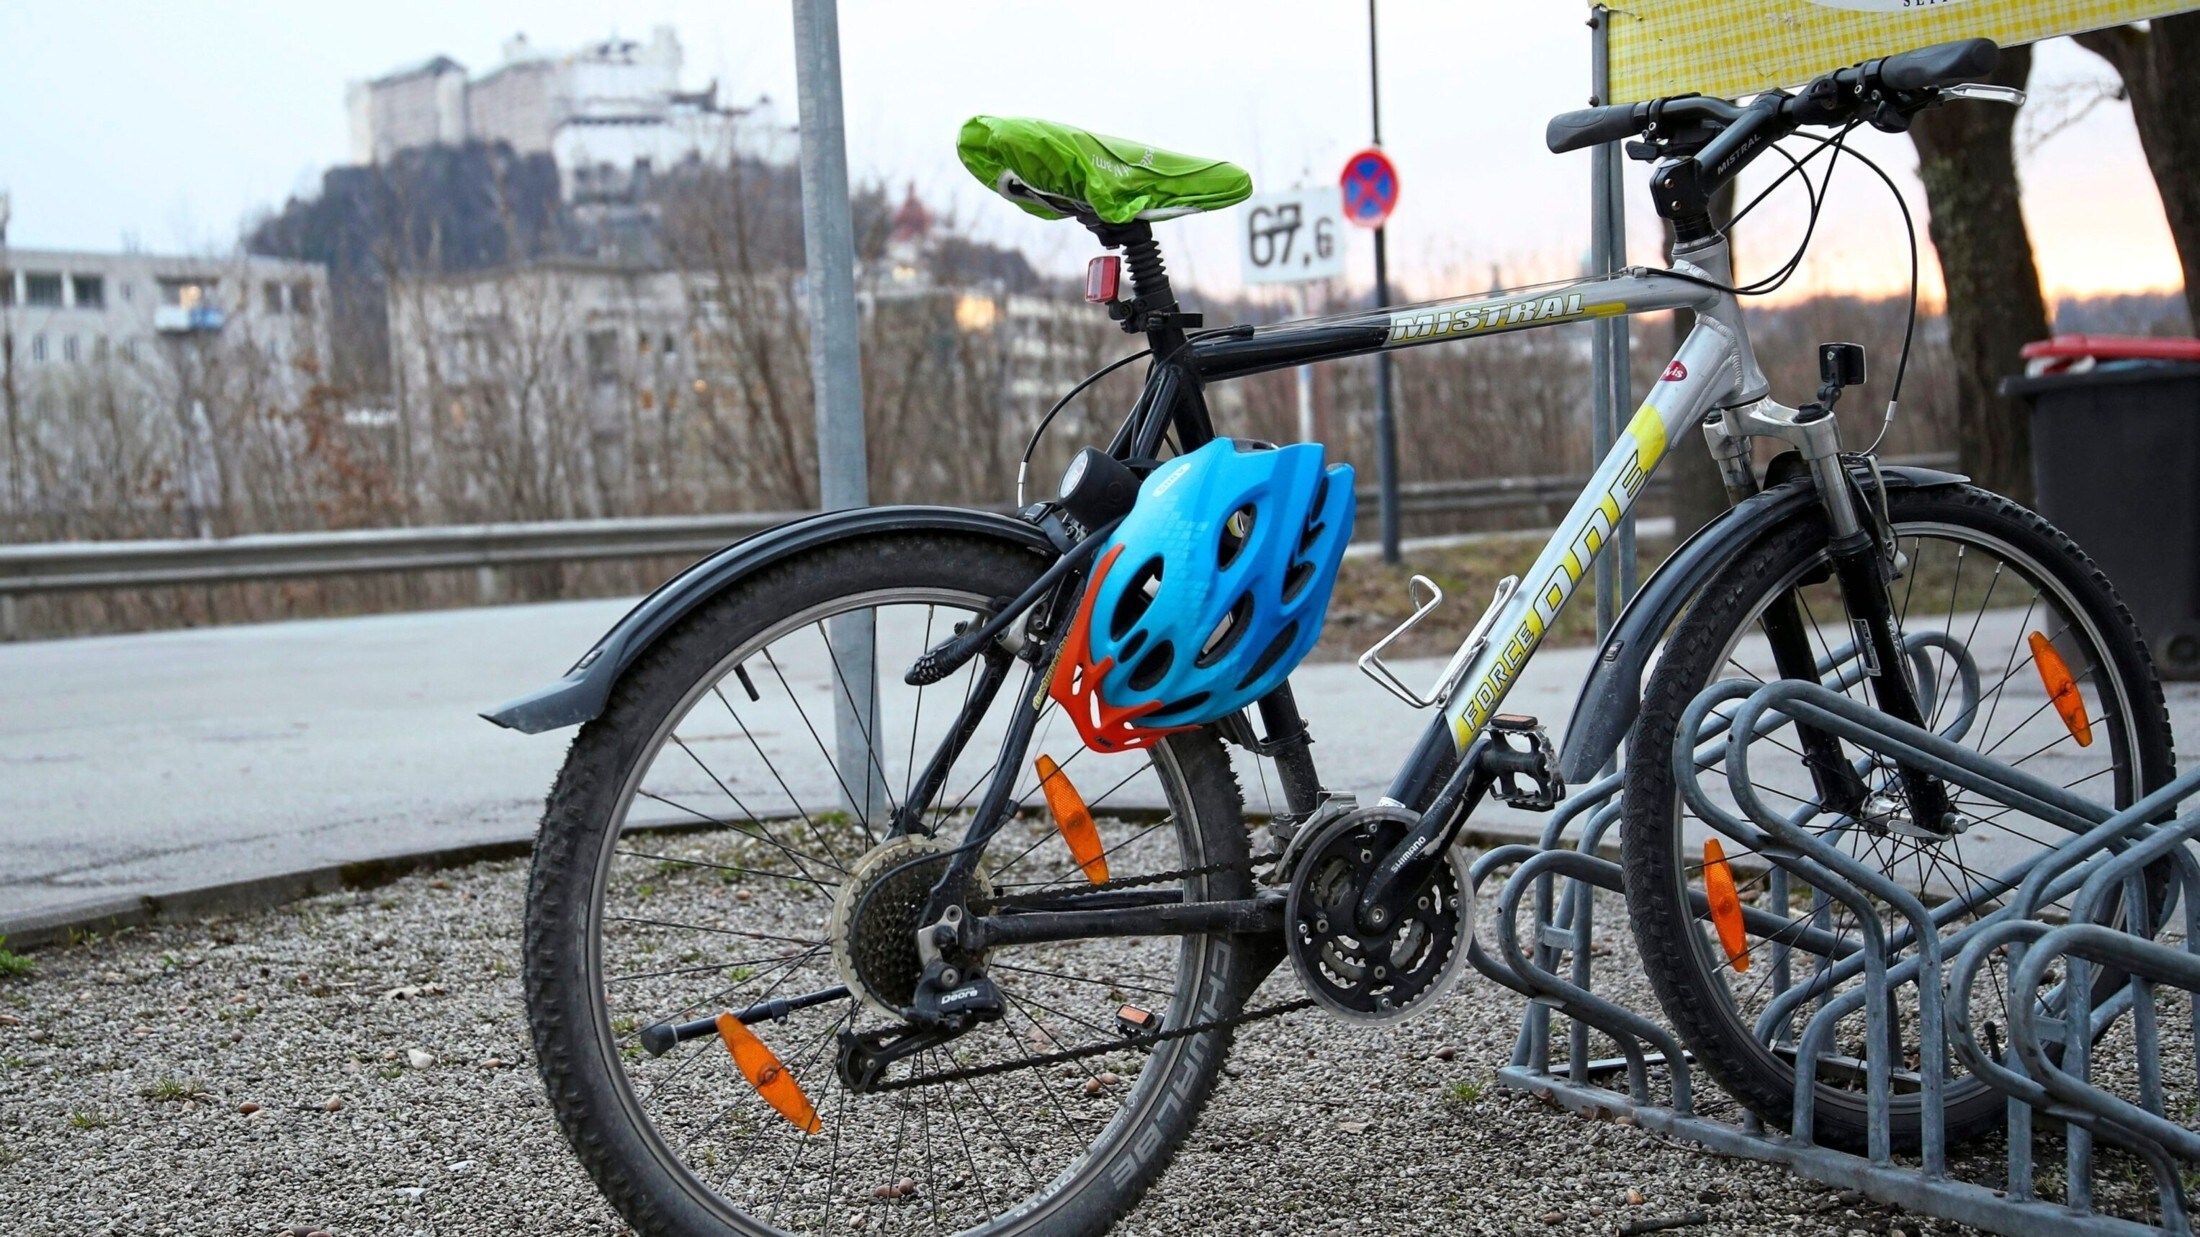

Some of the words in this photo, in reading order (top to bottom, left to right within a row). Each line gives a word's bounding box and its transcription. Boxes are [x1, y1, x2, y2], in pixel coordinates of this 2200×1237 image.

[1718, 134, 1761, 175] MISTRAL
[1391, 293, 1584, 341] MISTRAL
[1462, 620, 1534, 732] FORCE
[1391, 836, 1426, 874] SHIMANO
[1110, 934, 1232, 1190] CHWALBE
